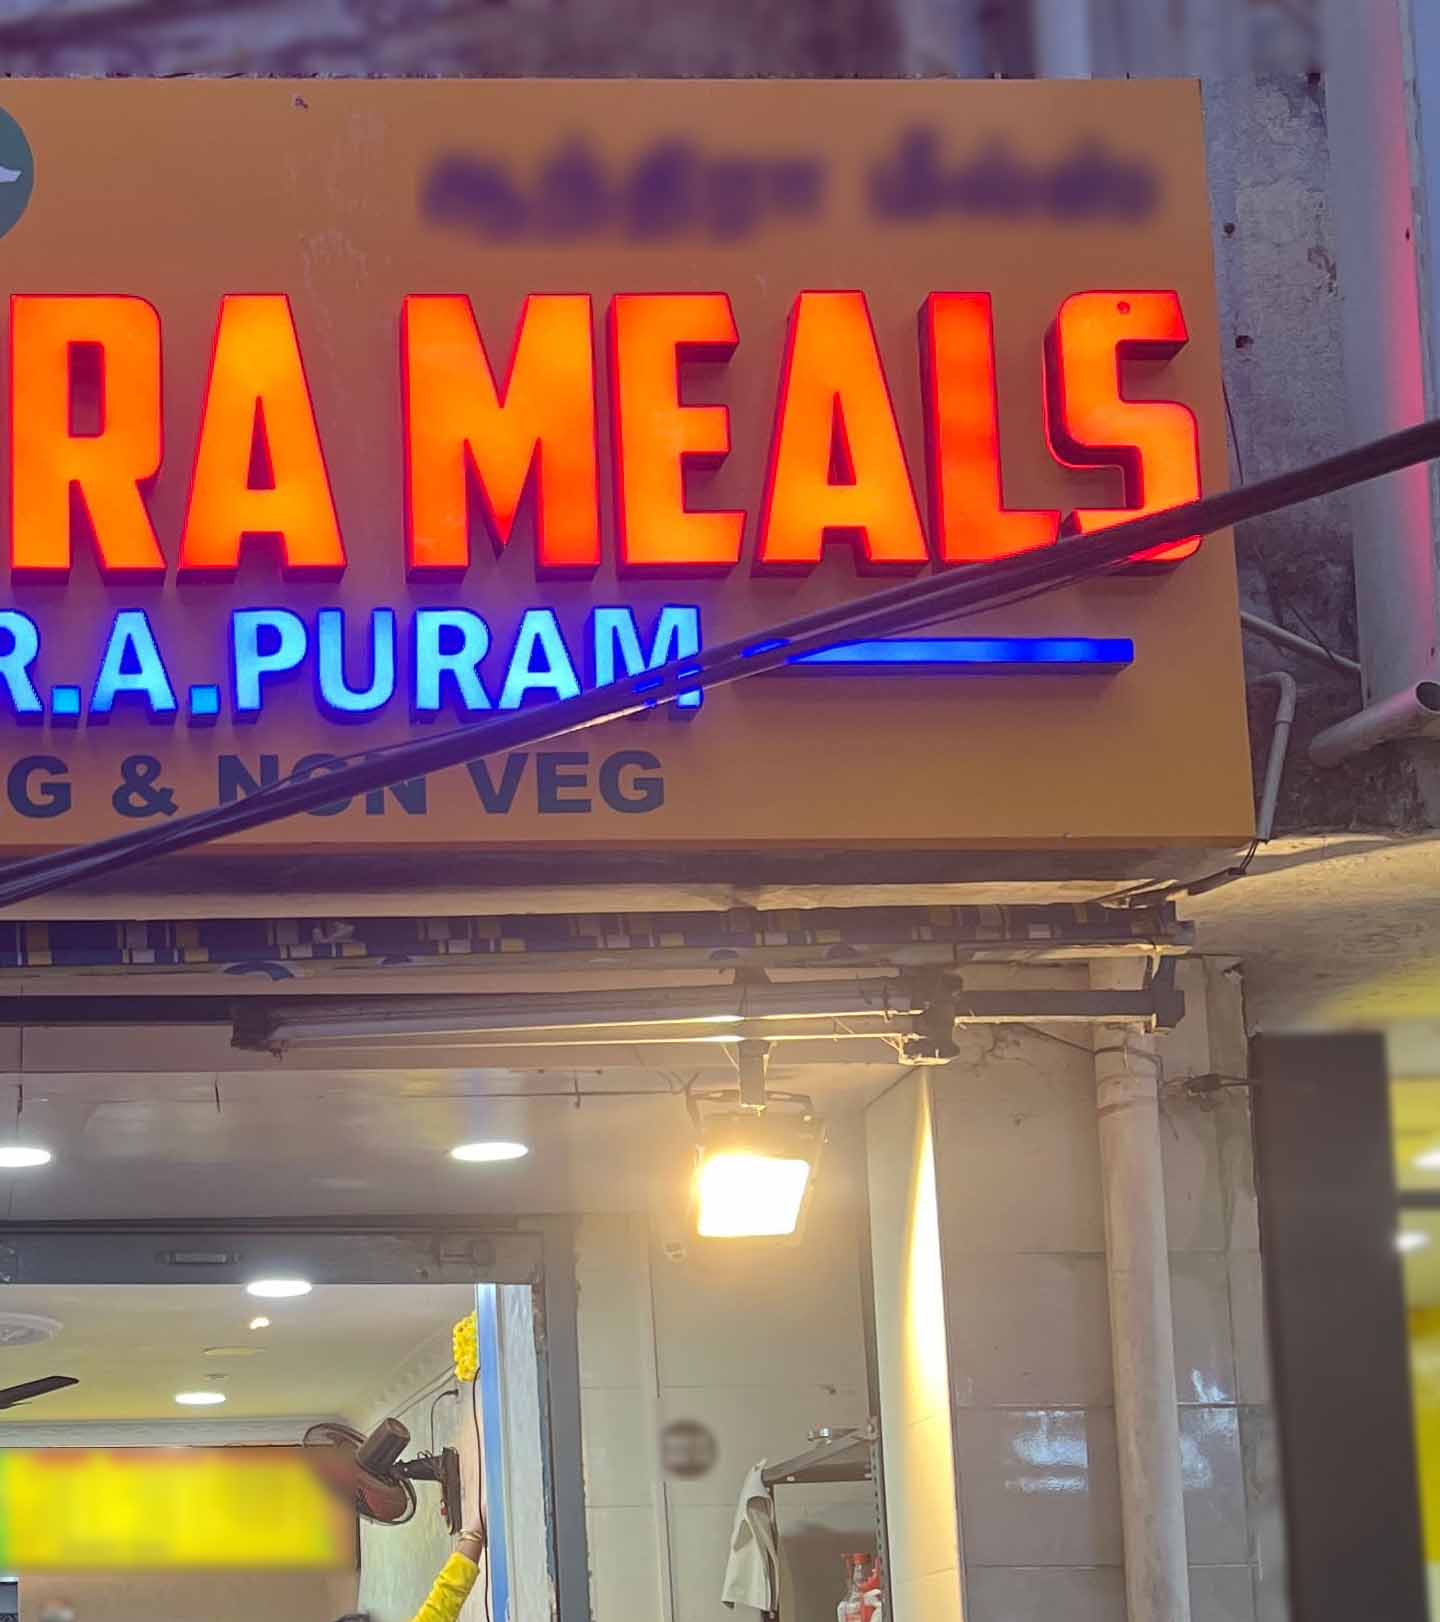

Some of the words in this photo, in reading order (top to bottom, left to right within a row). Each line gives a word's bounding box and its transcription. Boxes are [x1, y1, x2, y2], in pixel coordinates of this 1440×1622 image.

[398, 289, 1203, 574] MEALS
[112, 754, 177, 819] &
[467, 749, 665, 815] VEG
